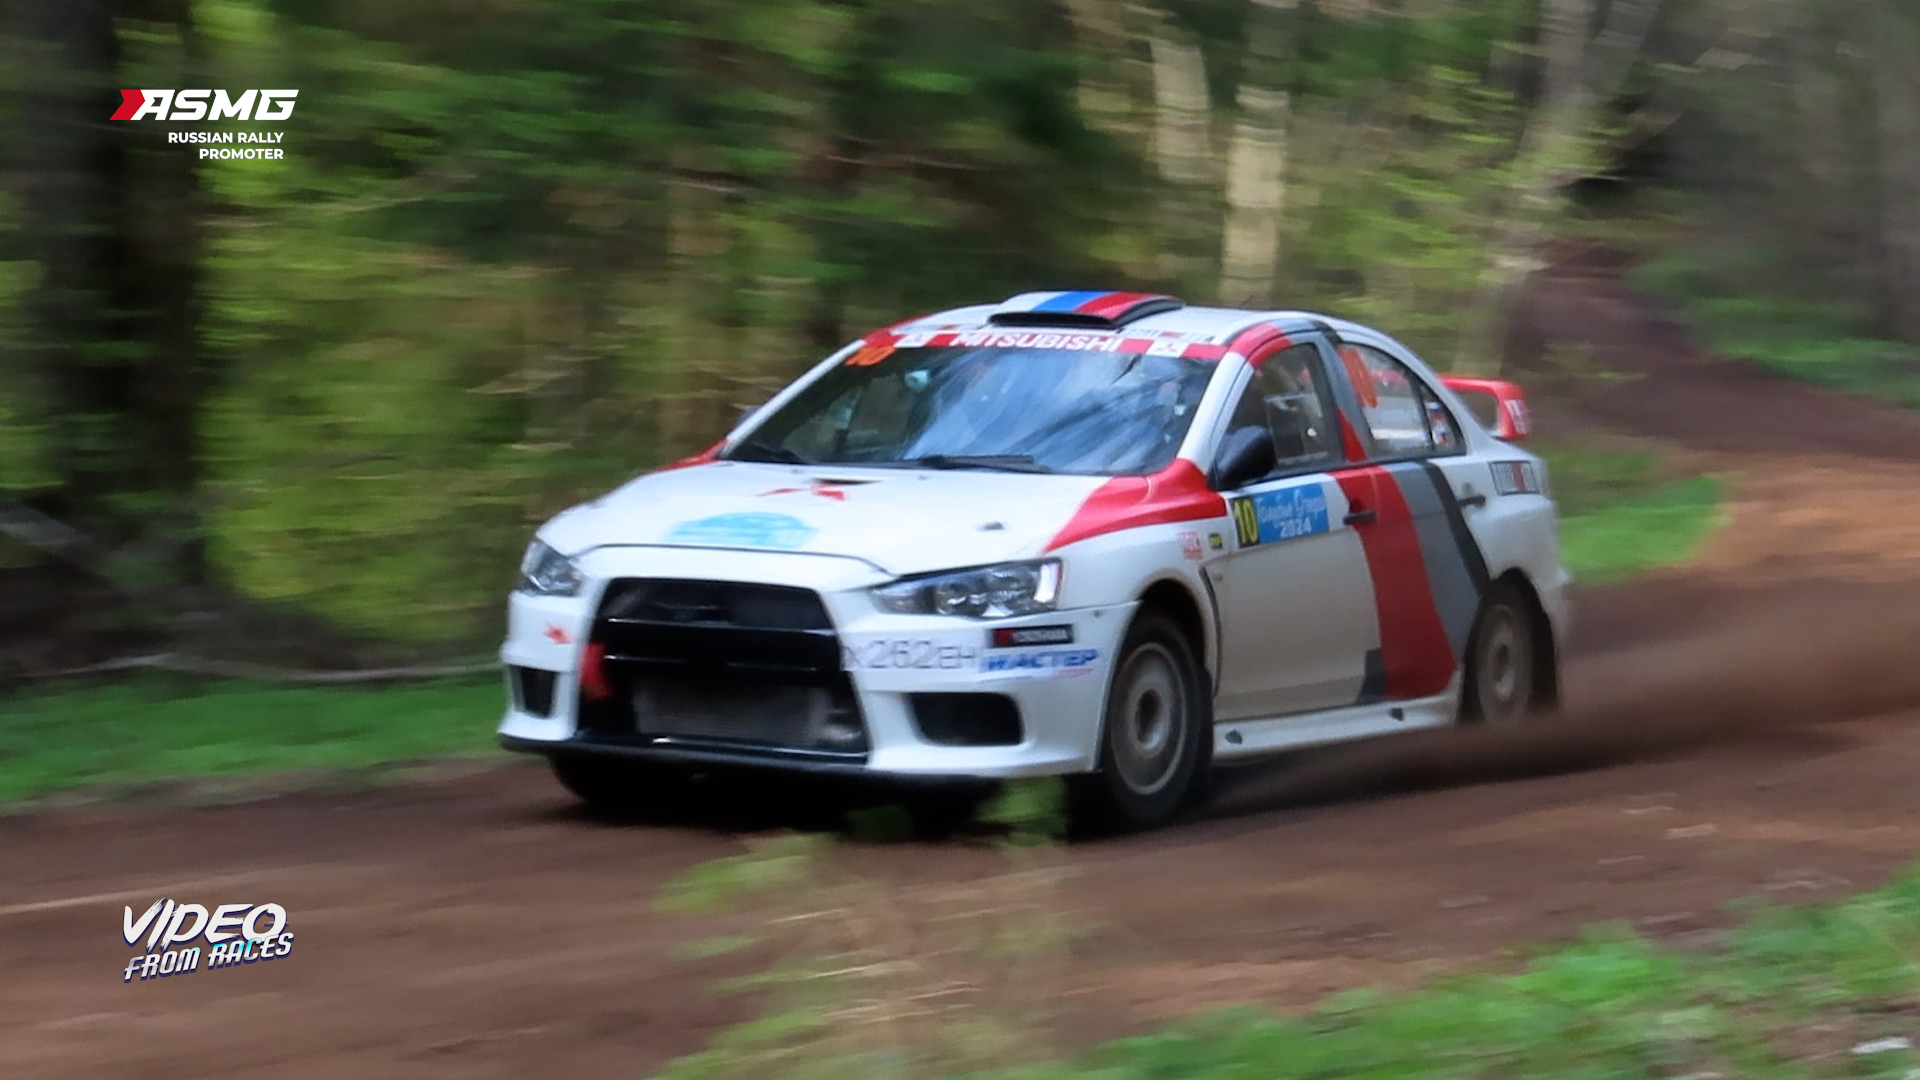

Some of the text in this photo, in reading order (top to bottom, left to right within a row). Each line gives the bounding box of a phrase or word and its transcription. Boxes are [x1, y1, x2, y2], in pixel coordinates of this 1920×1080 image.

[948, 332, 1123, 352] MITSUBISHI
[1233, 498, 1260, 546] 10
[1279, 516, 1312, 539] 2024
